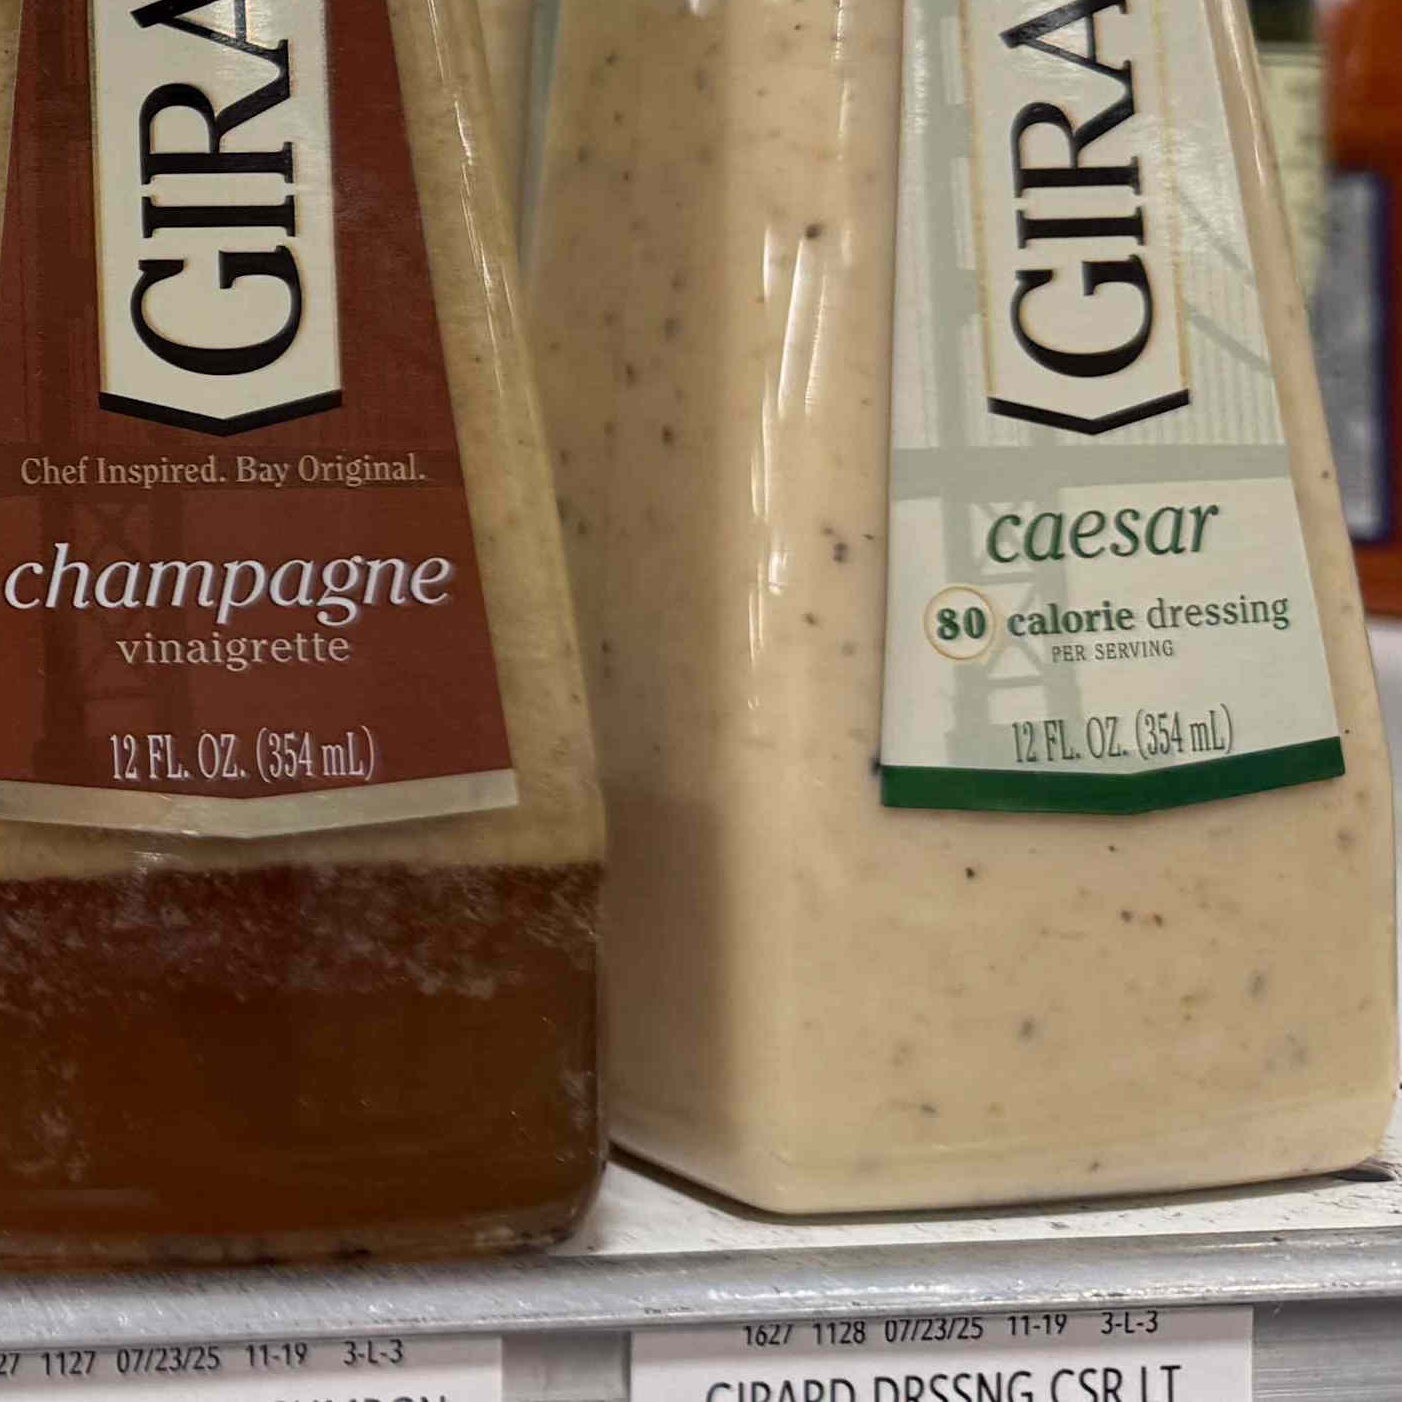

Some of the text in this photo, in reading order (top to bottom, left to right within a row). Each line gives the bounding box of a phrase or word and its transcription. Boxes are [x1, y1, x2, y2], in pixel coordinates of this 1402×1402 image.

[20, 452, 427, 489] Chef Inspired. Bay Original.
[985, 503, 1219, 564] caesar
[3, 543, 454, 626] champagne
[936, 594, 1291, 641] 80 calorie dressing
[116, 631, 353, 671] vinaigrette
[1051, 638, 1175, 664] PER SERVING
[109, 724, 375, 785] 12 FL. OZ. (354 mL)
[1012, 702, 1235, 764] 12 FL. OZ. (354 mL)
[812, 1320, 867, 1346] 1128
[884, 1316, 984, 1343] 07/23/25
[1007, 1313, 1068, 1338] 11-19
[1100, 1310, 1159, 1335] 3-L-3
[40, 1350, 96, 1376] 1127
[116, 1345, 221, 1373] 07/23/25
[245, 1342, 308, 1368] 11-19
[342, 1339, 405, 1365] 3-L-3
